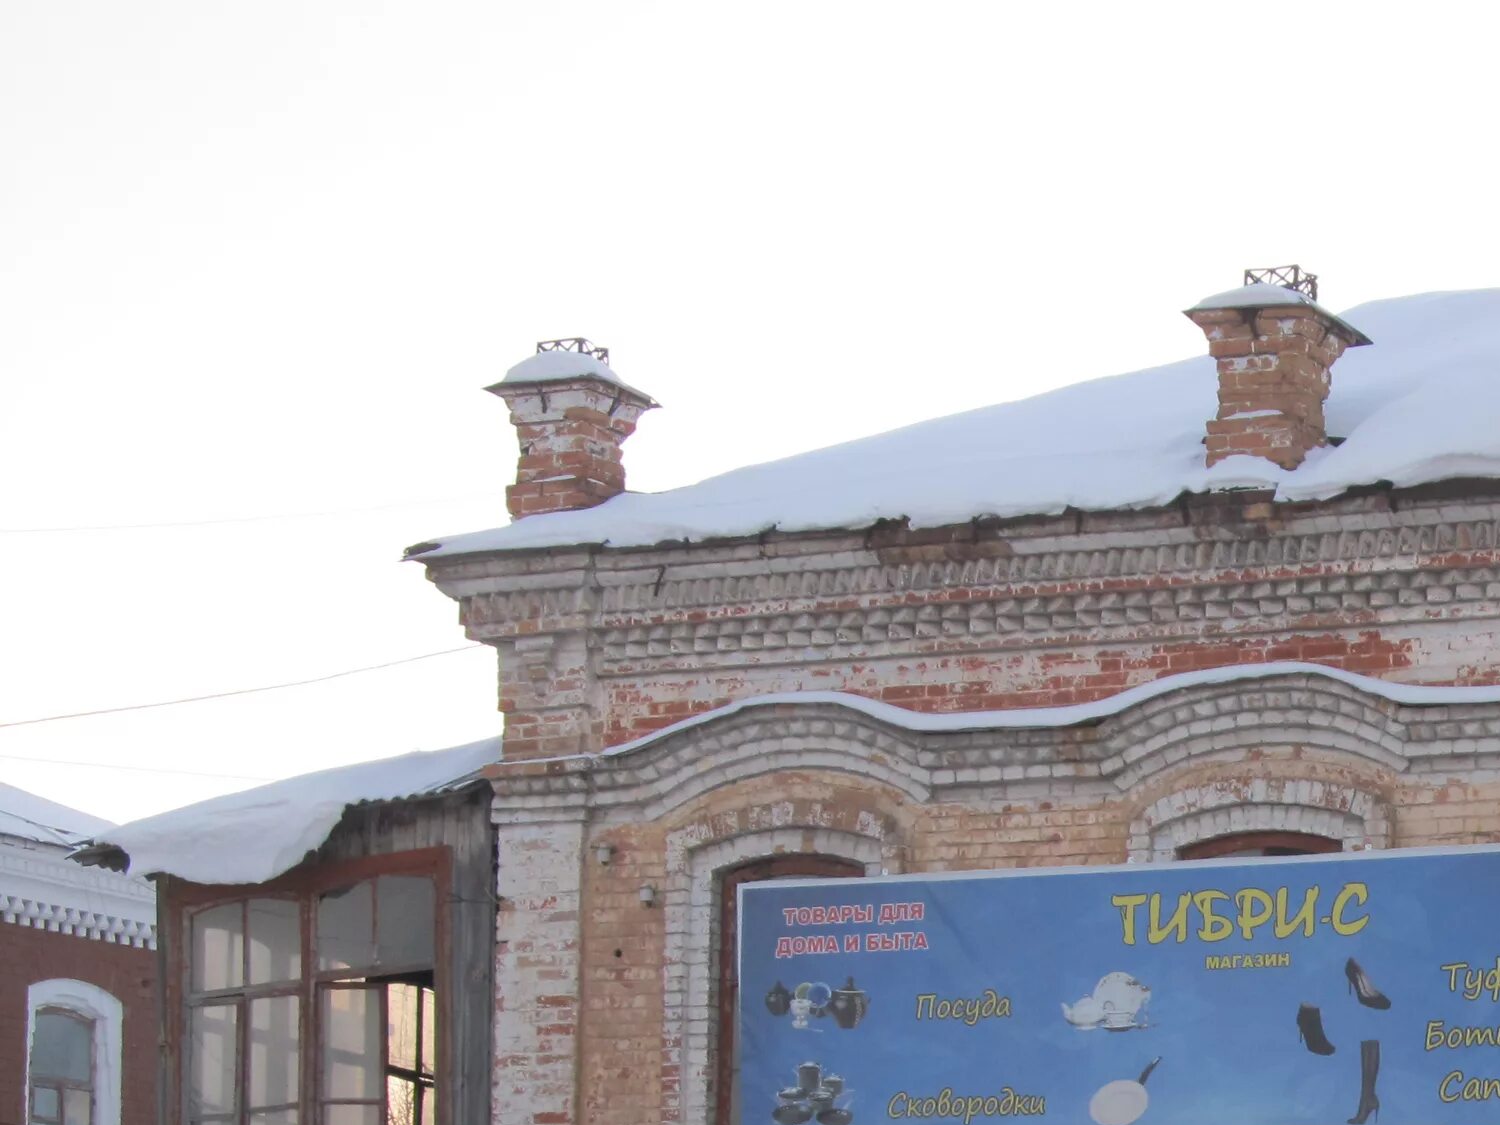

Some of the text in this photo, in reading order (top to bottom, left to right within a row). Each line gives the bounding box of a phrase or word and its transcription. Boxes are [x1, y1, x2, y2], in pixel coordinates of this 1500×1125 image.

[783, 901, 926, 928] ТОВАРЫ ДЛЯ
[775, 931, 929, 958] ДОМА И БЫТА
[1205, 953, 1290, 971] МАГАЗИН
[915, 989, 1012, 1026] Посуда
[887, 1088, 1046, 1125] Сковородки
